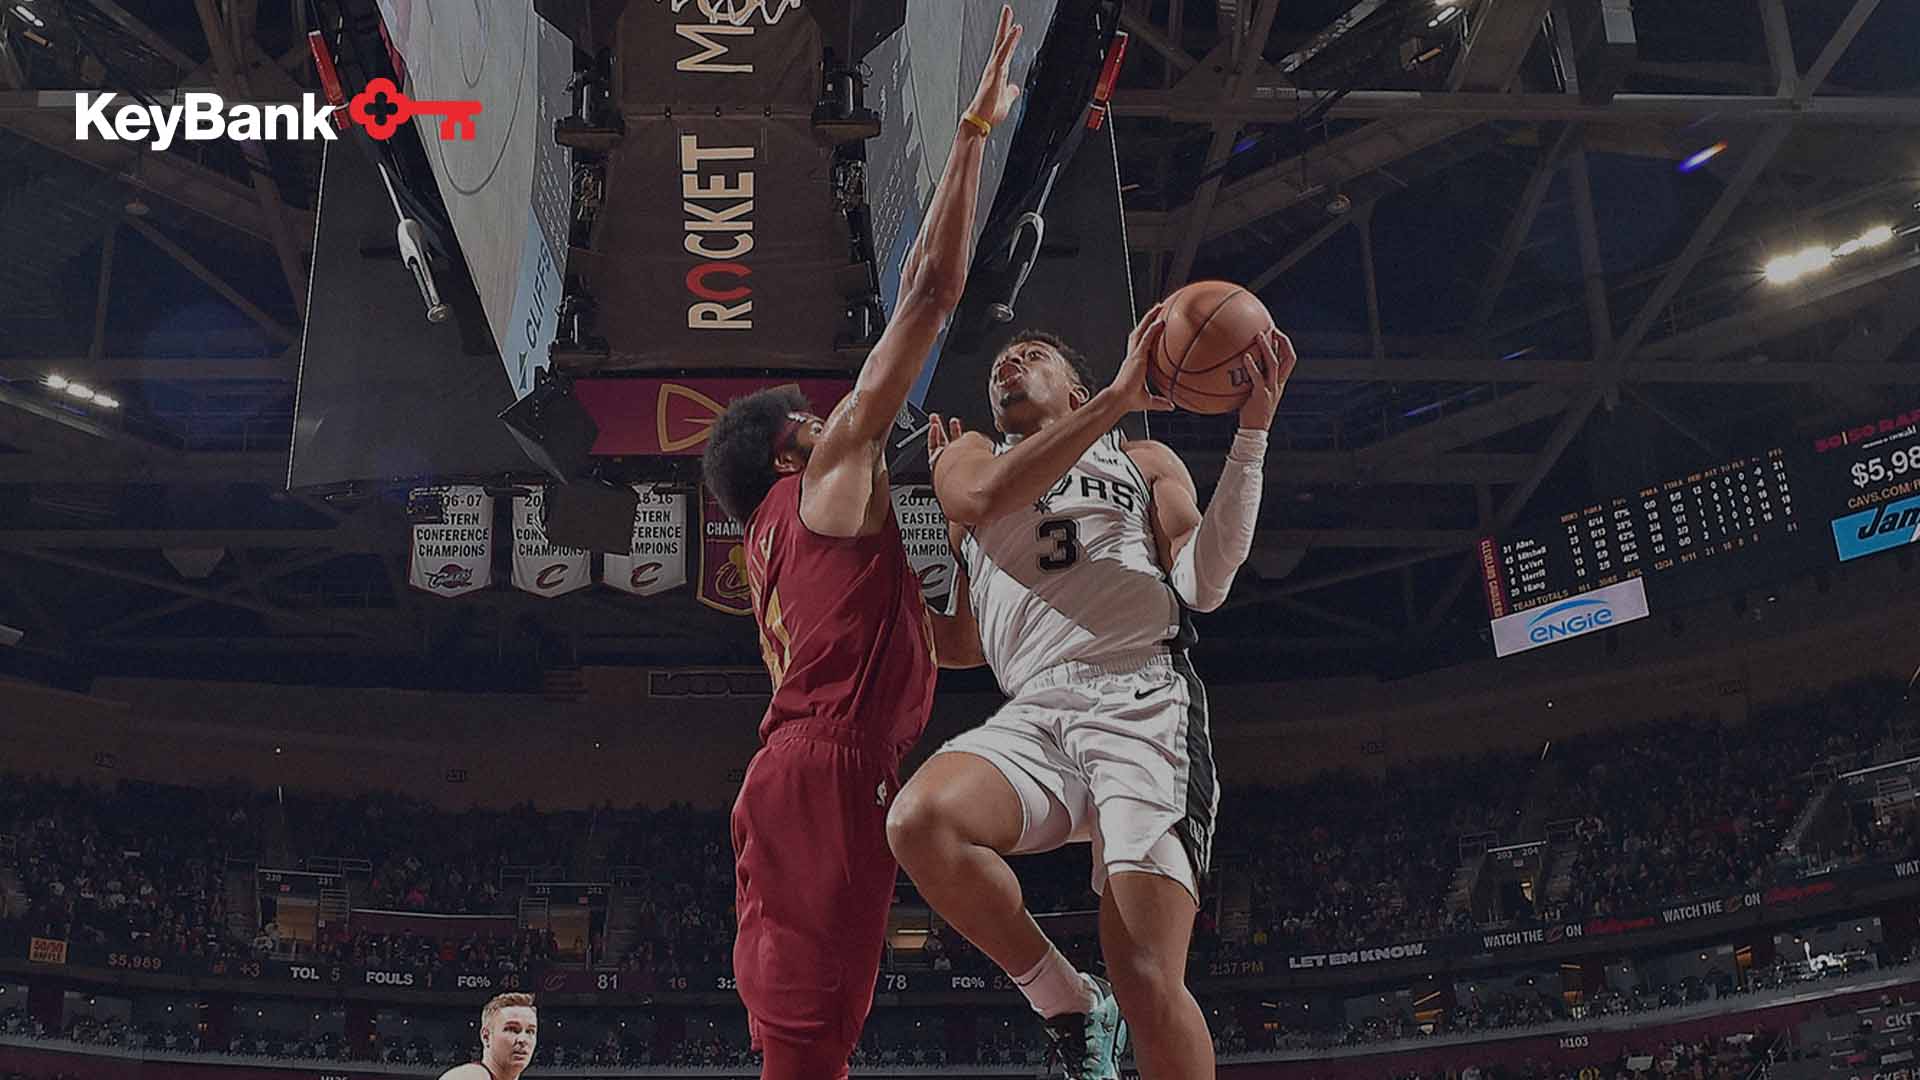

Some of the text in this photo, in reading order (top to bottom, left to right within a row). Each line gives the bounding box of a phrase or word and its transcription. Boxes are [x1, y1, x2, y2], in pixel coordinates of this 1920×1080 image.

[680, 134, 756, 331] ROCKET
[416, 528, 489, 541] CONFERENCE
[1036, 518, 1081, 573] 3
[418, 543, 485, 558] CHAMPIONS
[1512, 600, 1536, 612] TEAM
[1537, 589, 1569, 604] TOTALS
[1662, 903, 1701, 924] WATCH
[1700, 899, 1723, 916] THE
[1744, 891, 1761, 907] ON
[1482, 930, 1521, 949] WATCH
[1521, 928, 1544, 944] THE
[1565, 923, 1584, 938] ON
[1288, 952, 1327, 970] LET
[1360, 942, 1428, 965] KNOW.
[289, 965, 321, 981] TOL
[365, 971, 415, 986] FOULS
[457, 975, 492, 989] FG%
[597, 973, 619, 991] 81
[885, 973, 908, 991] 78
[951, 976, 985, 990] FG%
[1560, 1035, 1590, 1049] M103
